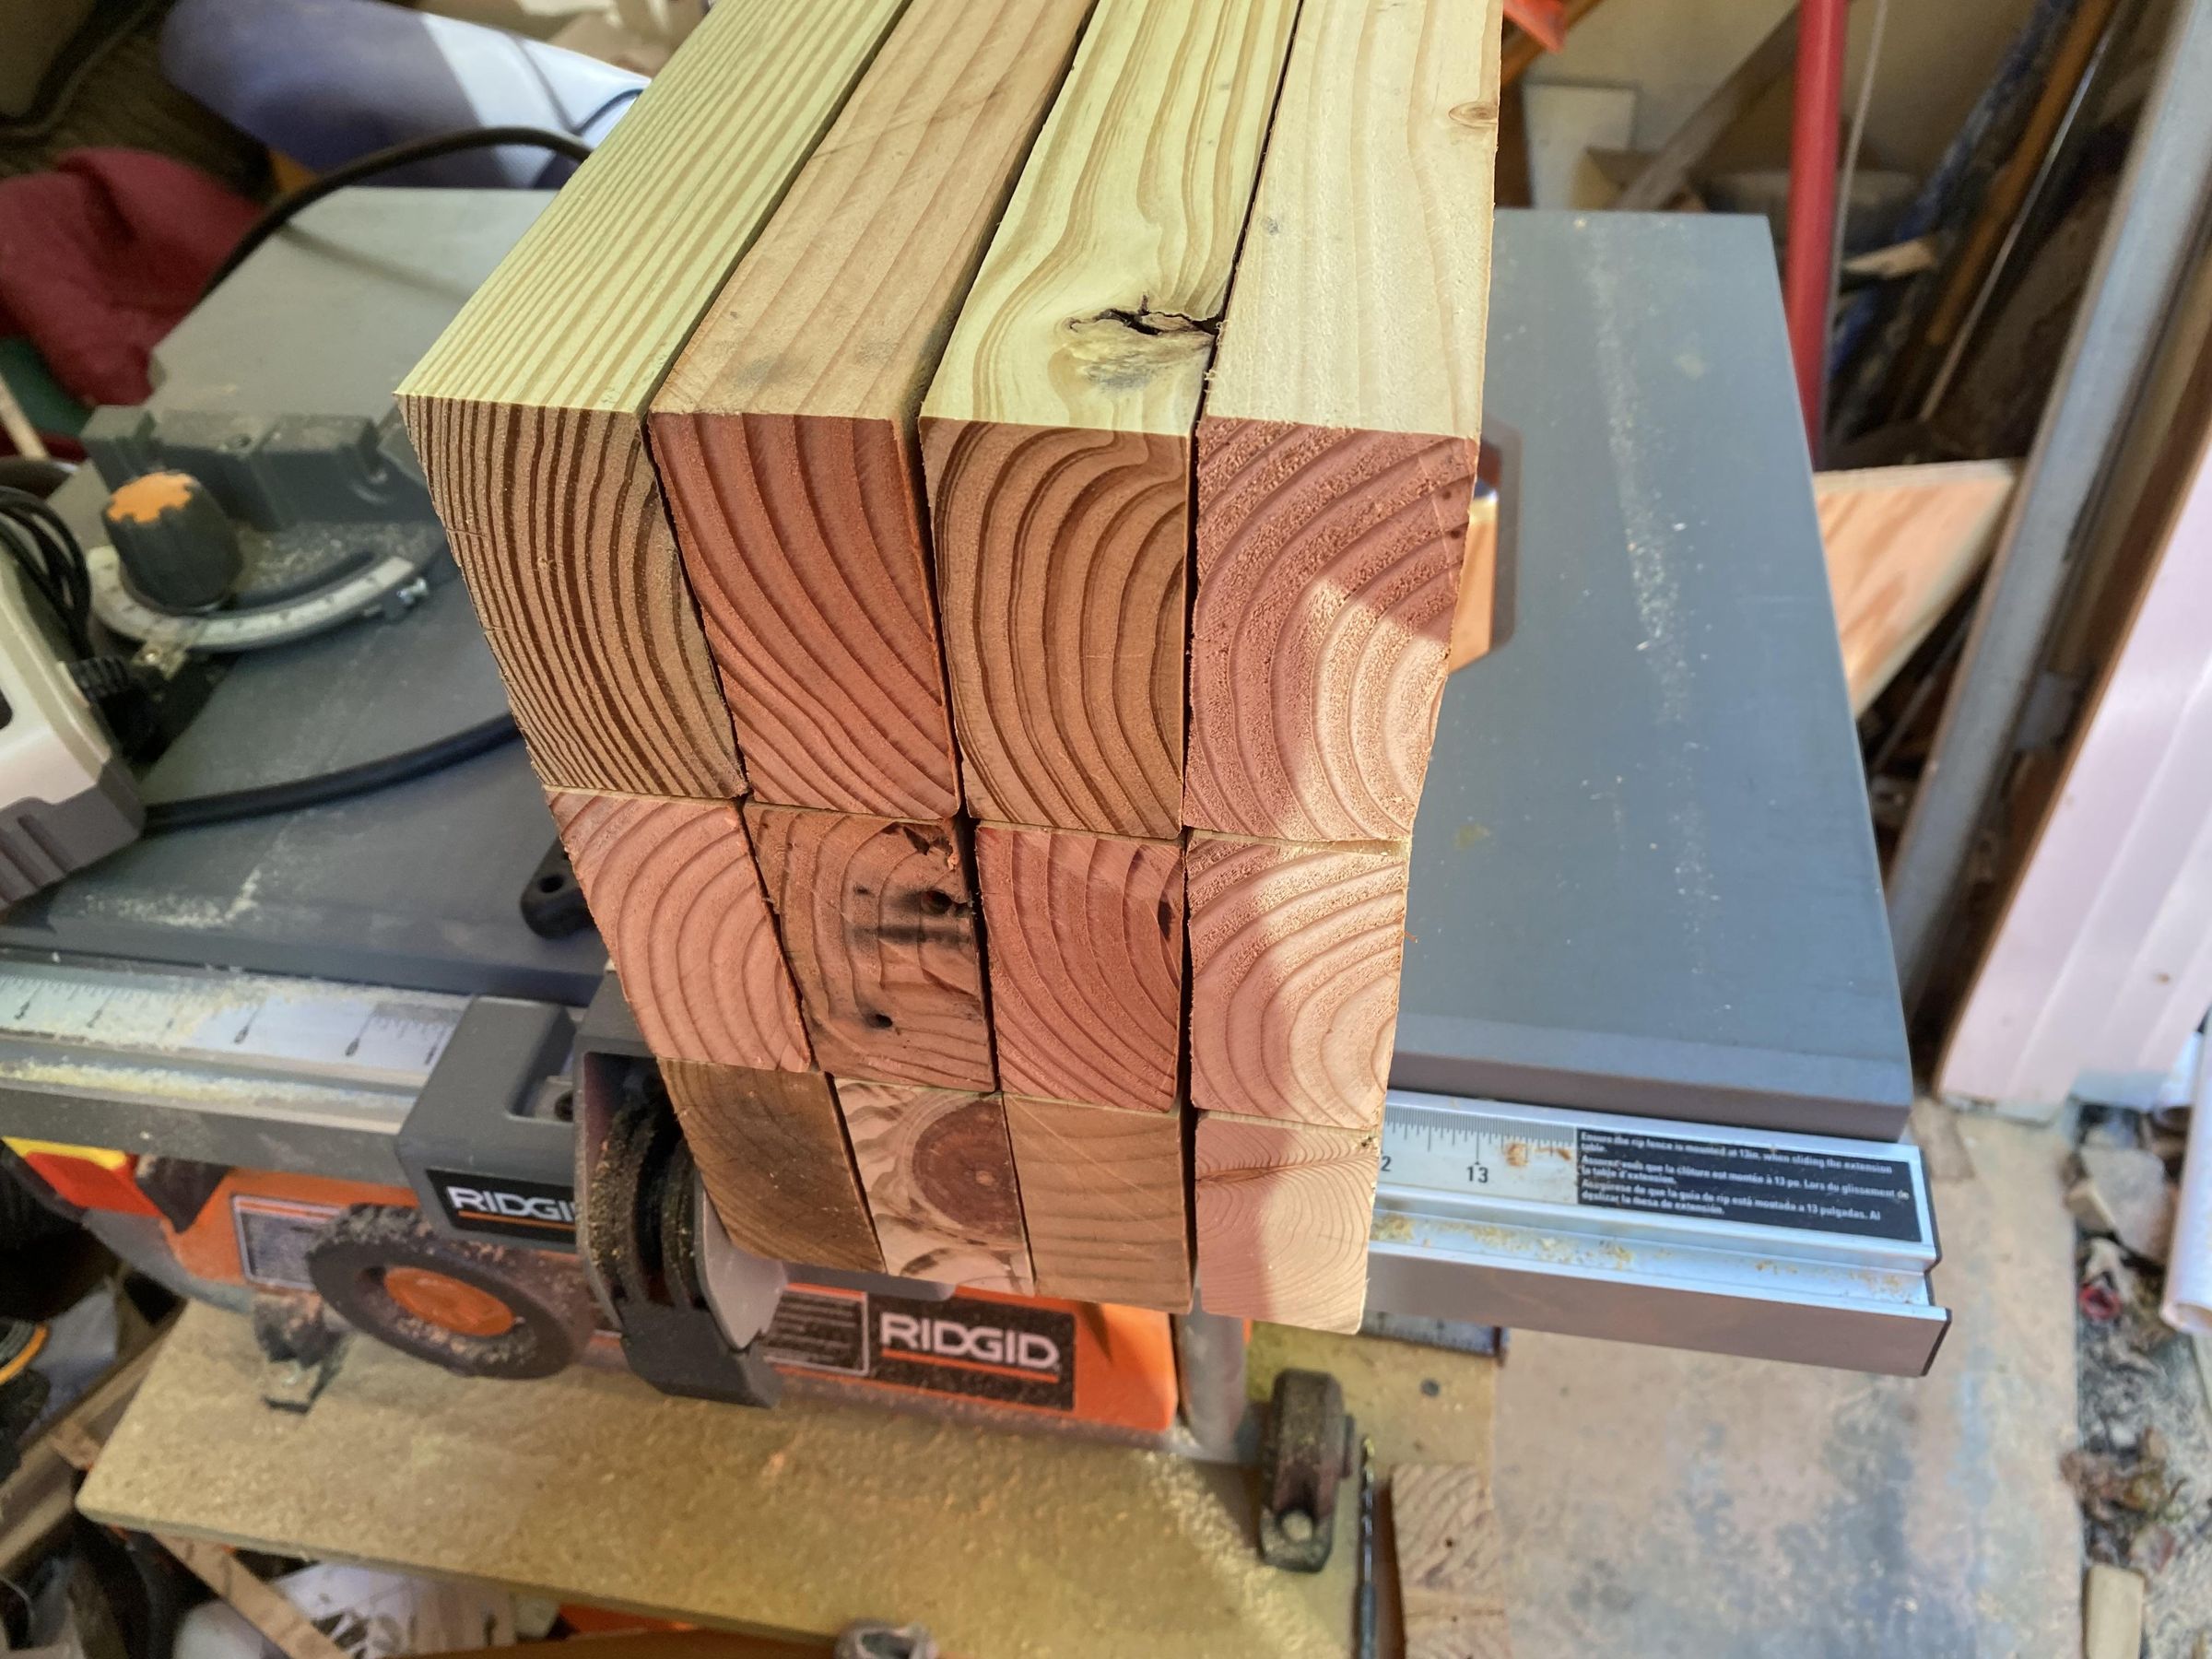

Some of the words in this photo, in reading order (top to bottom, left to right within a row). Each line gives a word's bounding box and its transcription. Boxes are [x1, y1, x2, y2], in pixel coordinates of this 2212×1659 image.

[1581, 1132, 1612, 1143] Ensure
[1614, 1135, 1630, 1146] the
[1631, 1136, 1645, 1148] rip
[1647, 1138, 1673, 1150] fence
[1675, 1141, 1684, 1151] is
[1685, 1143, 1725, 1157] mounted
[1728, 1147, 1737, 1157] at
[1763, 1152, 1790, 1163] when
[1792, 1155, 1825, 1168] sliding
[1827, 1158, 1841, 1168] the
[1844, 1160, 1892, 1173] extension
[1466, 1166, 1488, 1183] 13
[1645, 1163, 1663, 1172] que
[1665, 1164, 1675, 1174] la
[1712, 1171, 1727, 1180] est
[1774, 1176, 1785, 1186] 13
[1804, 1179, 1825, 1190] Lors
[1828, 1182, 1839, 1192] du
[1841, 1184, 1895, 1197] glissement
[446, 1186, 575, 1222] RIDGI
[1634, 1184, 1646, 1194] de
[1648, 1188, 1666, 1197] que
[1716, 1194, 1729, 1206] rip
[1755, 1198, 1796, 1210] montada
[1806, 1205, 1818, 1214] 13
[1660, 1199, 1673, 1208] de
[879, 1312, 1060, 1370] RIDGID
